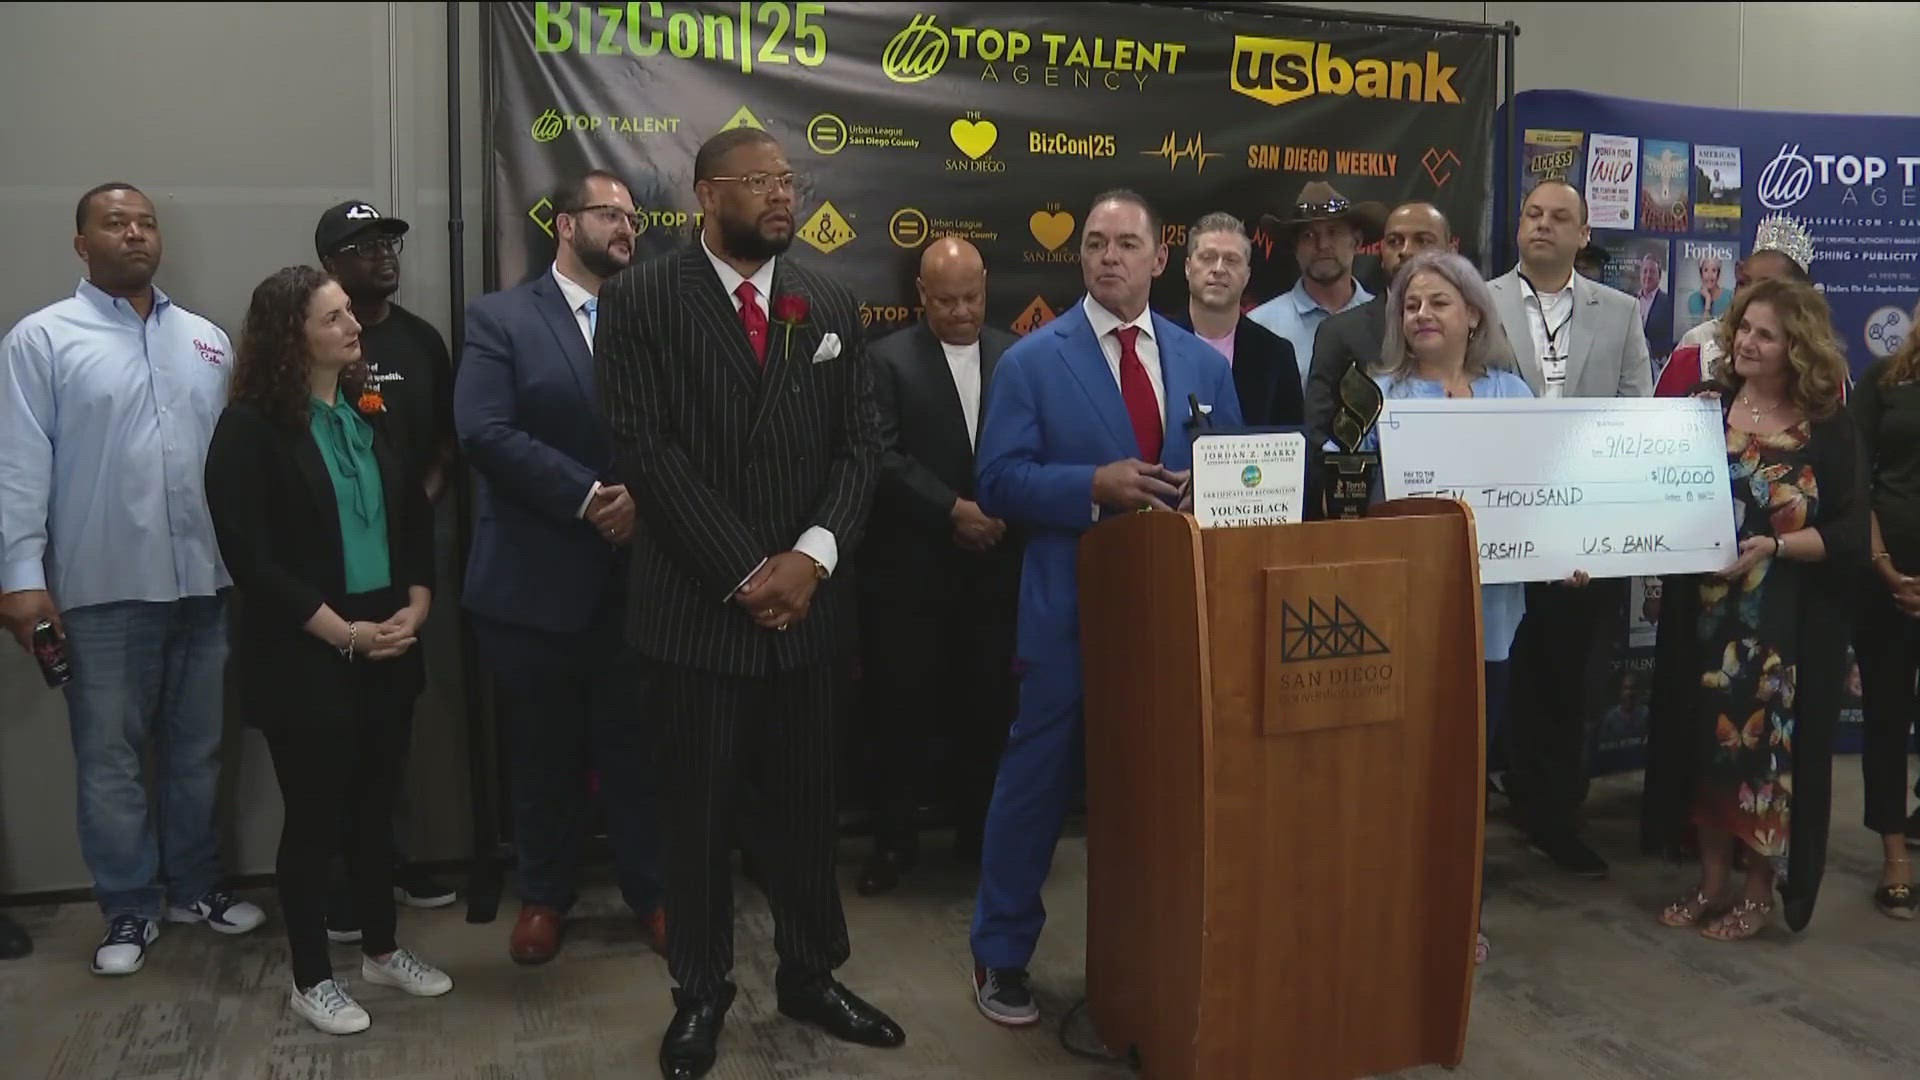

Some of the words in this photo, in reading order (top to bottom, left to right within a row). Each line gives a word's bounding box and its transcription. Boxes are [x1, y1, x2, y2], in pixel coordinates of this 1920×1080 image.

[951, 28, 1031, 63] TOP
[1042, 34, 1186, 75] TALENT
[980, 63, 1150, 92] AGENCY
[563, 115, 602, 131] TOP
[607, 117, 681, 133] TALENT
[849, 120, 874, 134] Urban
[875, 126, 904, 138] League
[849, 134, 865, 145] San
[866, 137, 890, 148] Diego
[891, 137, 920, 149] County
[1247, 145, 1281, 170] SAN
[1284, 147, 1330, 173] DIEGO
[1335, 151, 1398, 177] WEEKLY
[1532, 149, 1575, 172] ACCESS
[1698, 151, 1736, 160] AMERICAN
[945, 159, 969, 171] SAN
[970, 160, 1007, 172] DIEGO
[1591, 157, 1633, 184] WILD
[1813, 155, 1887, 186] TOP
[1841, 187, 1917, 207] AGE
[649, 210, 688, 227] TOP
[930, 219, 954, 228] Urban
[955, 220, 983, 231] League
[930, 229, 945, 239] San
[970, 231, 998, 241] County
[1023, 251, 1045, 262] SAN
[1684, 241, 1733, 260] Forbes
[1813, 251, 1850, 261] ISHING
[1862, 252, 1918, 261] PUBLICITY
[872, 306, 909, 322] TOP
[1204, 451, 1245, 461] JORDAN
[1264, 449, 1296, 457] MARKS
[1346, 481, 1367, 490] Torch
[1482, 487, 1583, 508] THOUSAND
[1210, 504, 1250, 517] YOUNG
[1253, 502, 1289, 514] BLACK
[1238, 515, 1287, 528] BUSINESS
[1480, 541, 1535, 559] ORSHIP
[1582, 537, 1616, 554] U.S.
[1622, 535, 1671, 553] BANK
[1280, 671, 1321, 691] SAN
[1330, 665, 1393, 686] DIEGO
